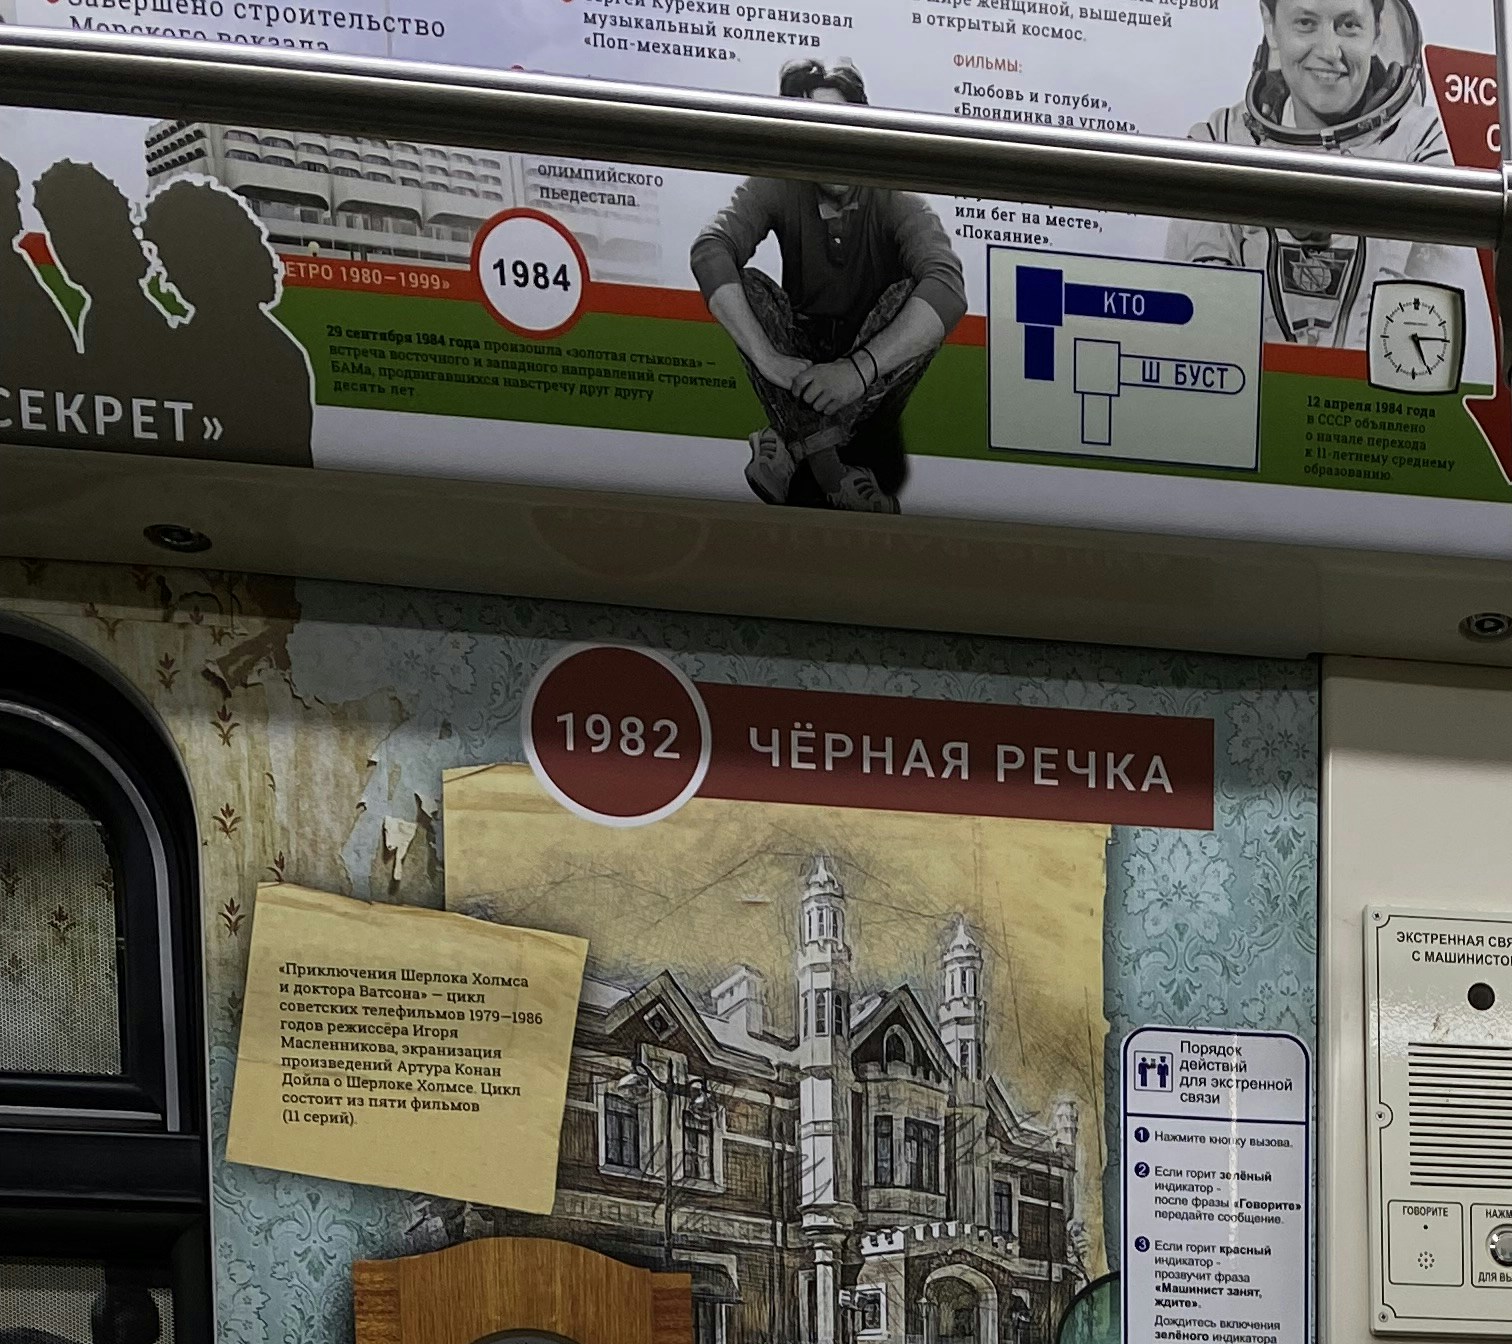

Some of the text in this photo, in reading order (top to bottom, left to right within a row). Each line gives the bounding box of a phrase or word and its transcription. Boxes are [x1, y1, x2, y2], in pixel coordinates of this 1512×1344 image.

[234, 3, 446, 38] строительство
[736, 4, 853, 29] организовал
[912, 12, 1086, 41] в открытый космос.
[583, 12, 820, 47] музыкальный коллектив
[584, 33, 741, 62] «Поп-механика».
[953, 53, 1023, 73] ФИЛЬМЫ:
[954, 81, 1112, 112] «Любовь и голуби»,
[537, 162, 664, 188] олимпийского
[539, 185, 639, 208] пьедестала.
[955, 206, 1103, 233] или бег на месте»,
[954, 224, 1054, 246] «Покаяние».
[282, 259, 333, 282] ЕТРО
[491, 257, 572, 293] 1984
[1103, 290, 1145, 316] КТО
[1142, 360, 1229, 390] Ш БУСТ
[1307, 395, 1436, 418] 12 апреля 1984 года
[555, 712, 681, 760] 1982
[748, 721, 1174, 795] ЧЁРНАЯ РЕЧКА
[1396, 931, 1484, 948] ЭКСТРЕННАЯ
[1412, 951, 1421, 962] С
[278, 962, 529, 988] «Приключения Шерлока Холмса
[279, 983, 485, 1005] и доктора Ватсона» цикл
[279, 1001, 543, 1025] советских телефильмов 1979–1986
[1180, 1040, 1243, 1057] Порядок
[1179, 1059, 1248, 1073] действий
[1179, 1076, 1206, 1088] для
[1180, 1092, 1220, 1104] связи
[1402, 1205, 1449, 1218] ГОВОРИТЕ
[1478, 1272, 1497, 1284] ДЛЯ
